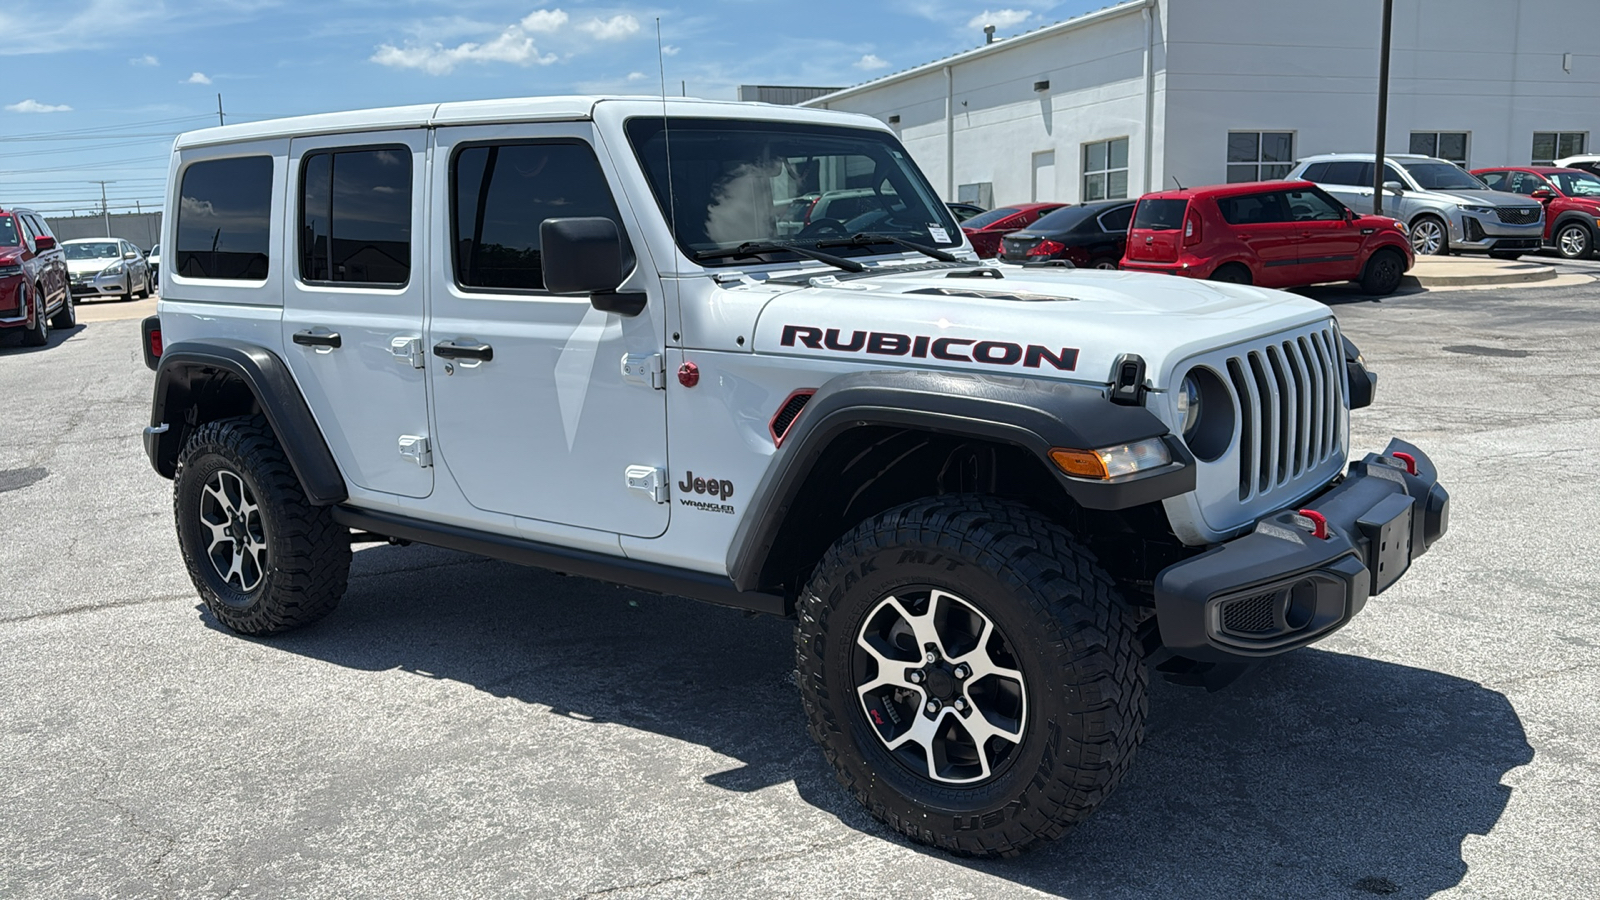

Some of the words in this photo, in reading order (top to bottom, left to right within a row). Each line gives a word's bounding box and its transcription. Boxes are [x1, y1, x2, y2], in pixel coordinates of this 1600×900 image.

[780, 324, 1080, 371] RUBICON
[678, 471, 734, 501] Jeep
[680, 499, 734, 511] WRANGLER
